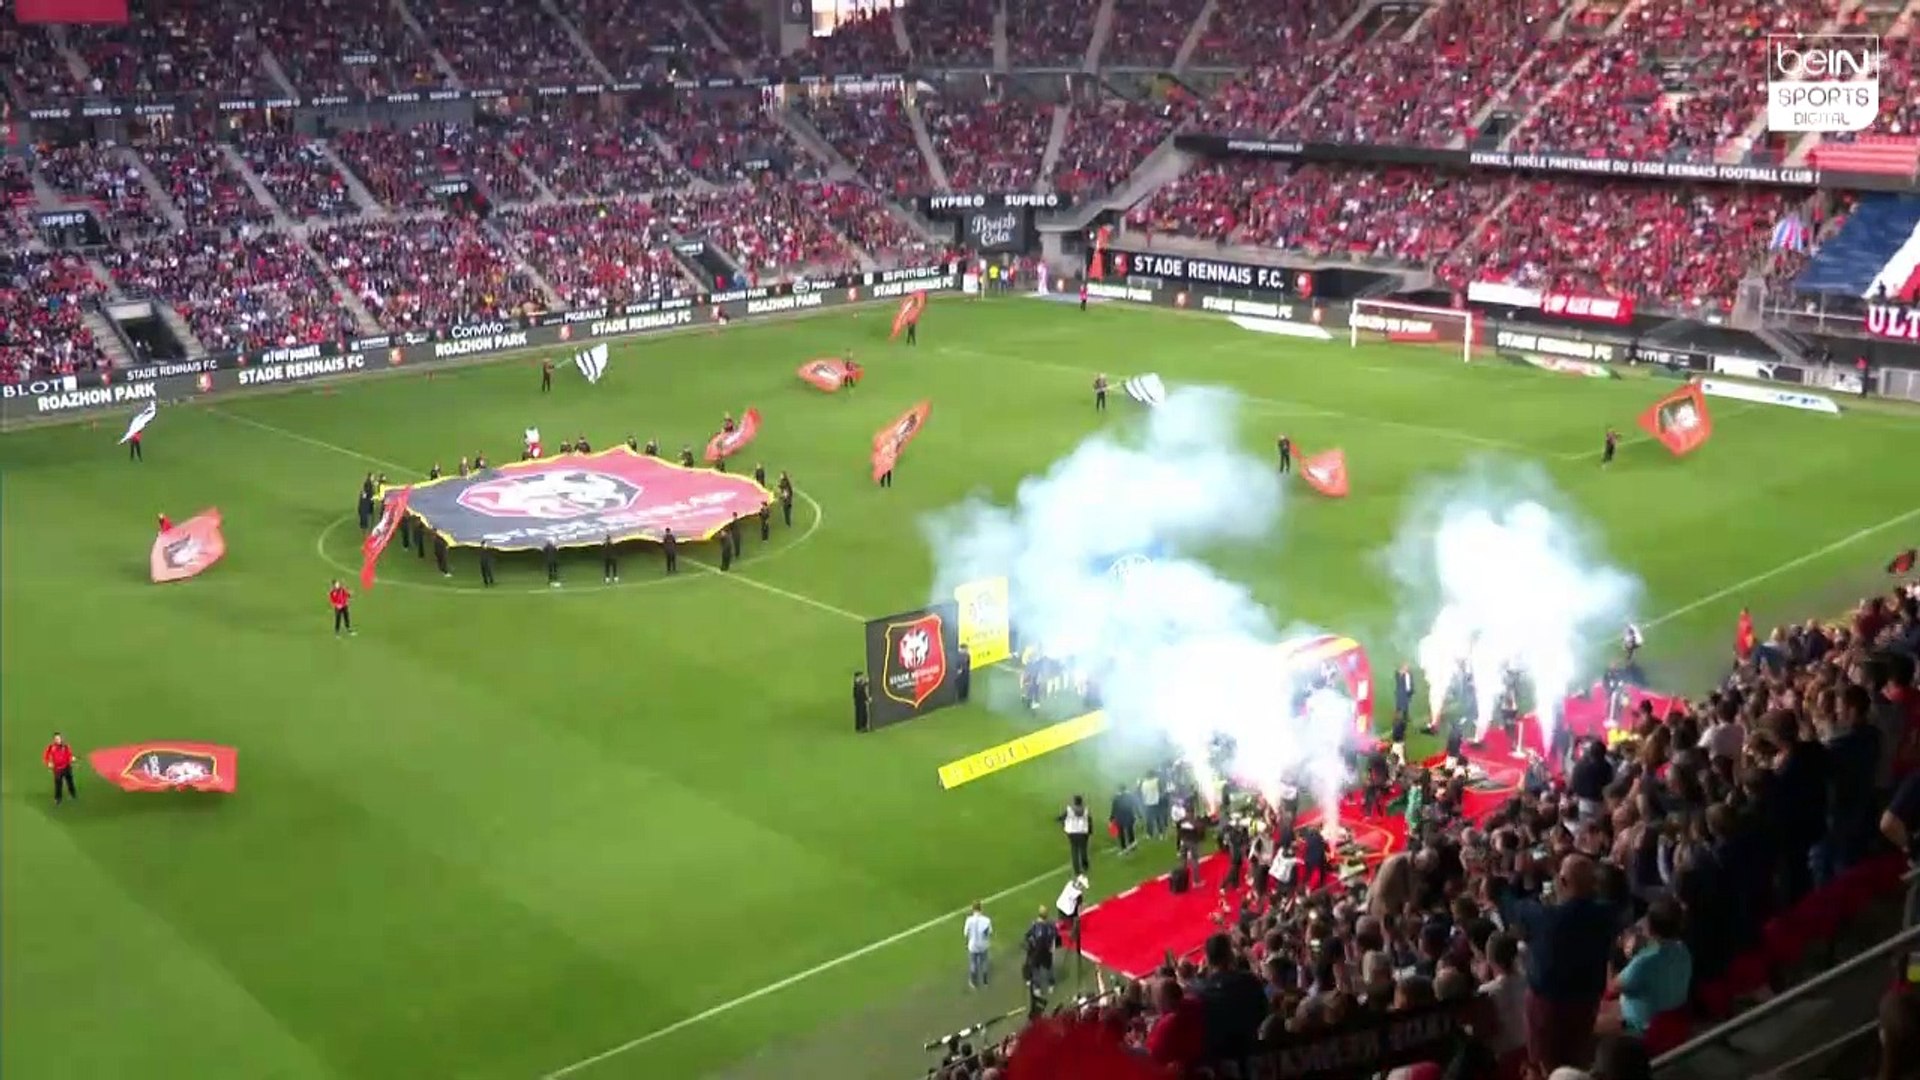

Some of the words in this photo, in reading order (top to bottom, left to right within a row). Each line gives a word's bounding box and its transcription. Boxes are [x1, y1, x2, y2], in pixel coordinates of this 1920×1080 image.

[1549, 157, 1609, 172] PARTENAIRE
[1612, 160, 1629, 172] DU
[1632, 161, 1665, 175] STADE
[1668, 164, 1717, 178] RENNAIS
[1719, 166, 1779, 181] FOOTBALL
[1780, 170, 1813, 183] CLUB
[931, 194, 972, 208] HYPER
[1004, 194, 1045, 206] SUPER
[1134, 255, 1182, 277] STADE
[1188, 261, 1252, 284] RENNAIS
[1258, 270, 1284, 288] F.C.
[591, 319, 627, 336] STADE
[678, 310, 692, 323] FC
[435, 338, 493, 358] ROAZHON
[495, 331, 527, 348] PARK
[127, 370, 158, 381] STADE
[160, 363, 201, 377] RENNAIS
[238, 365, 284, 385] STADE
[286, 358, 345, 379] RENNAIS
[347, 353, 364, 369] FC
[3, 377, 62, 398] BLOT
[38, 387, 112, 412] ROAZHON
[114, 382, 156, 400] PARK
